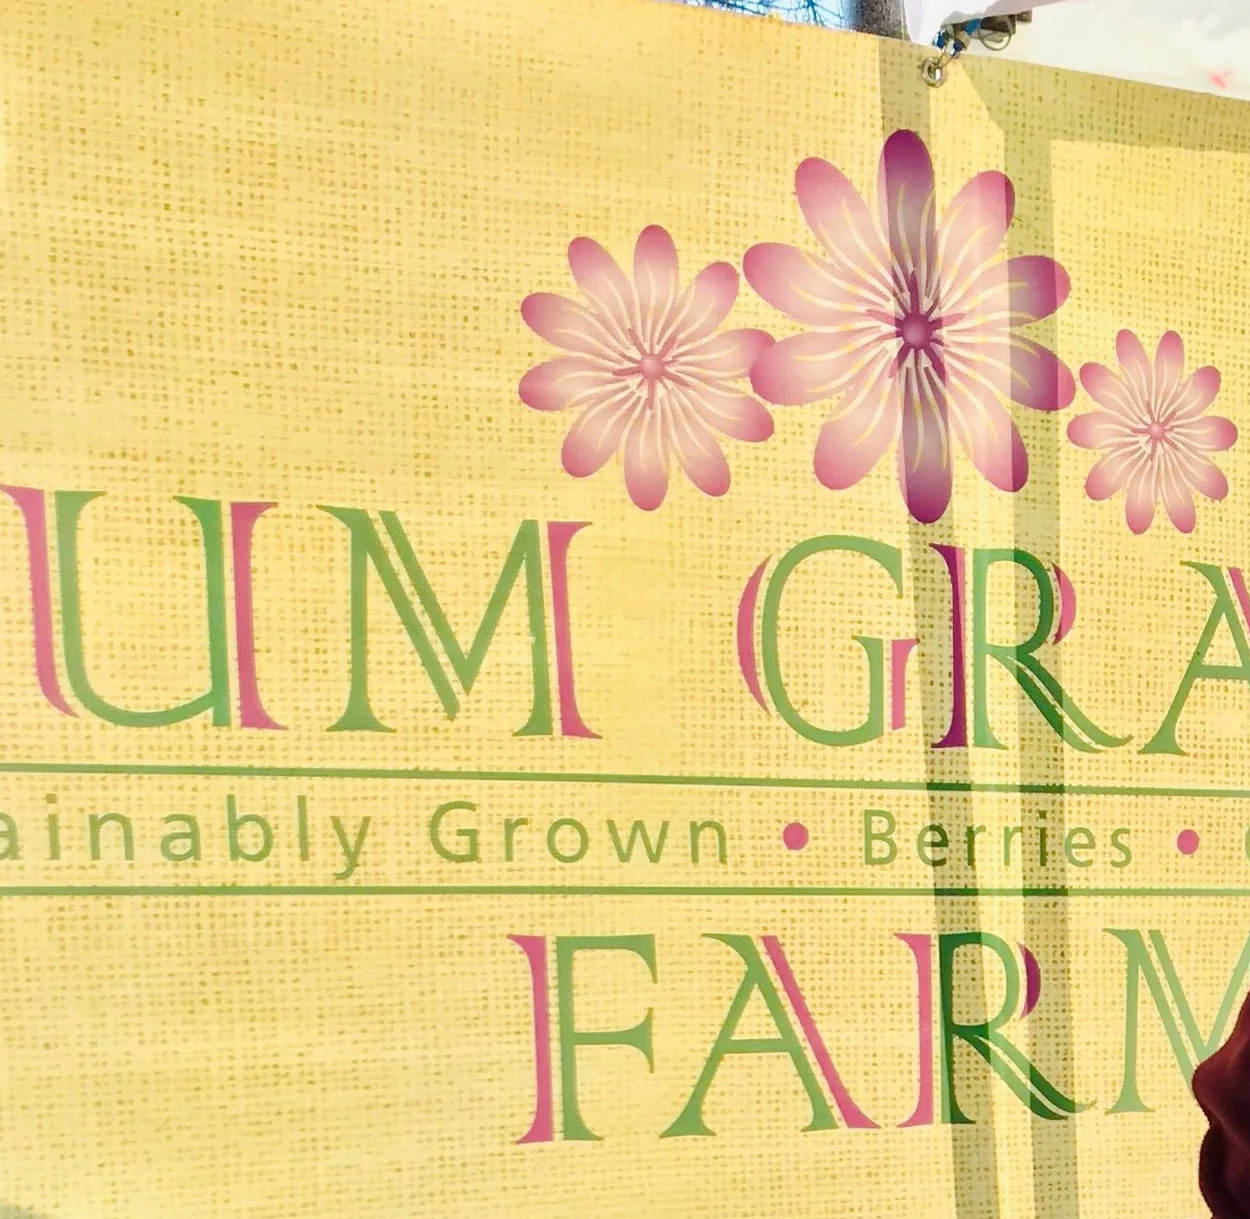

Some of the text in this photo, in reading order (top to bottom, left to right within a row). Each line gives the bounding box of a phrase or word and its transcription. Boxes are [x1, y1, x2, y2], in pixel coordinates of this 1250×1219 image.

[0, 484, 603, 740] UM
[430, 800, 729, 864] Grown
[863, 809, 1133, 868] Berries
